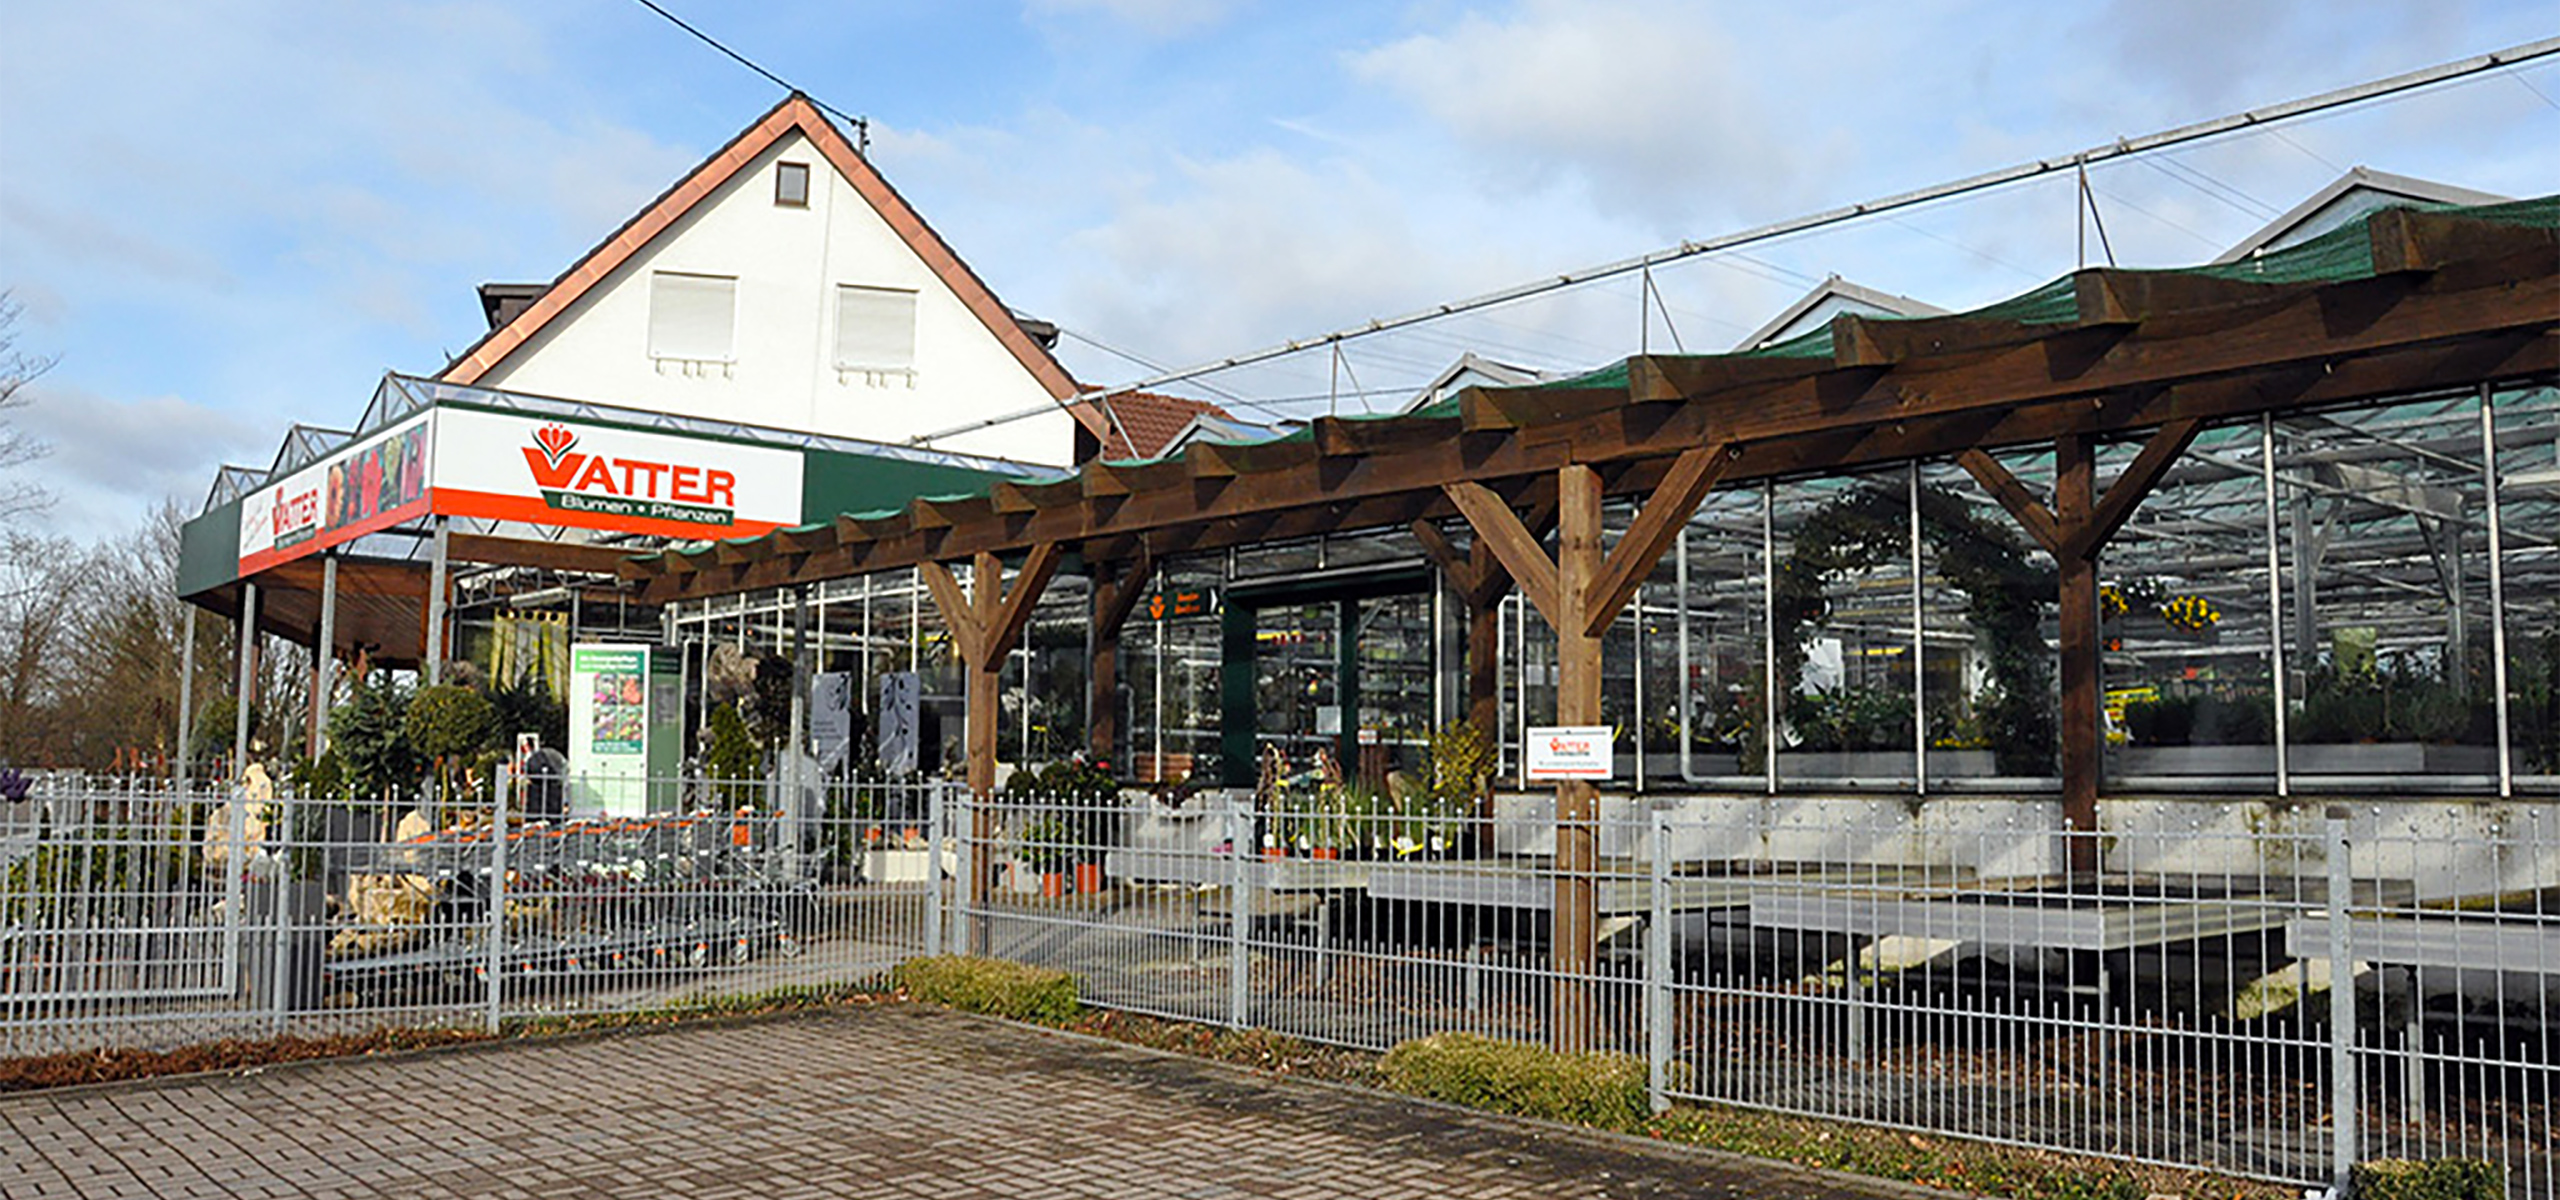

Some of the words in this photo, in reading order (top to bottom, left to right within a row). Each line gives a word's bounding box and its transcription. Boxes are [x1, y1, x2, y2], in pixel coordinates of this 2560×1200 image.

[521, 446, 736, 507] VATTER
[561, 493, 632, 514] Blumen
[651, 503, 727, 524] Pflanzen
